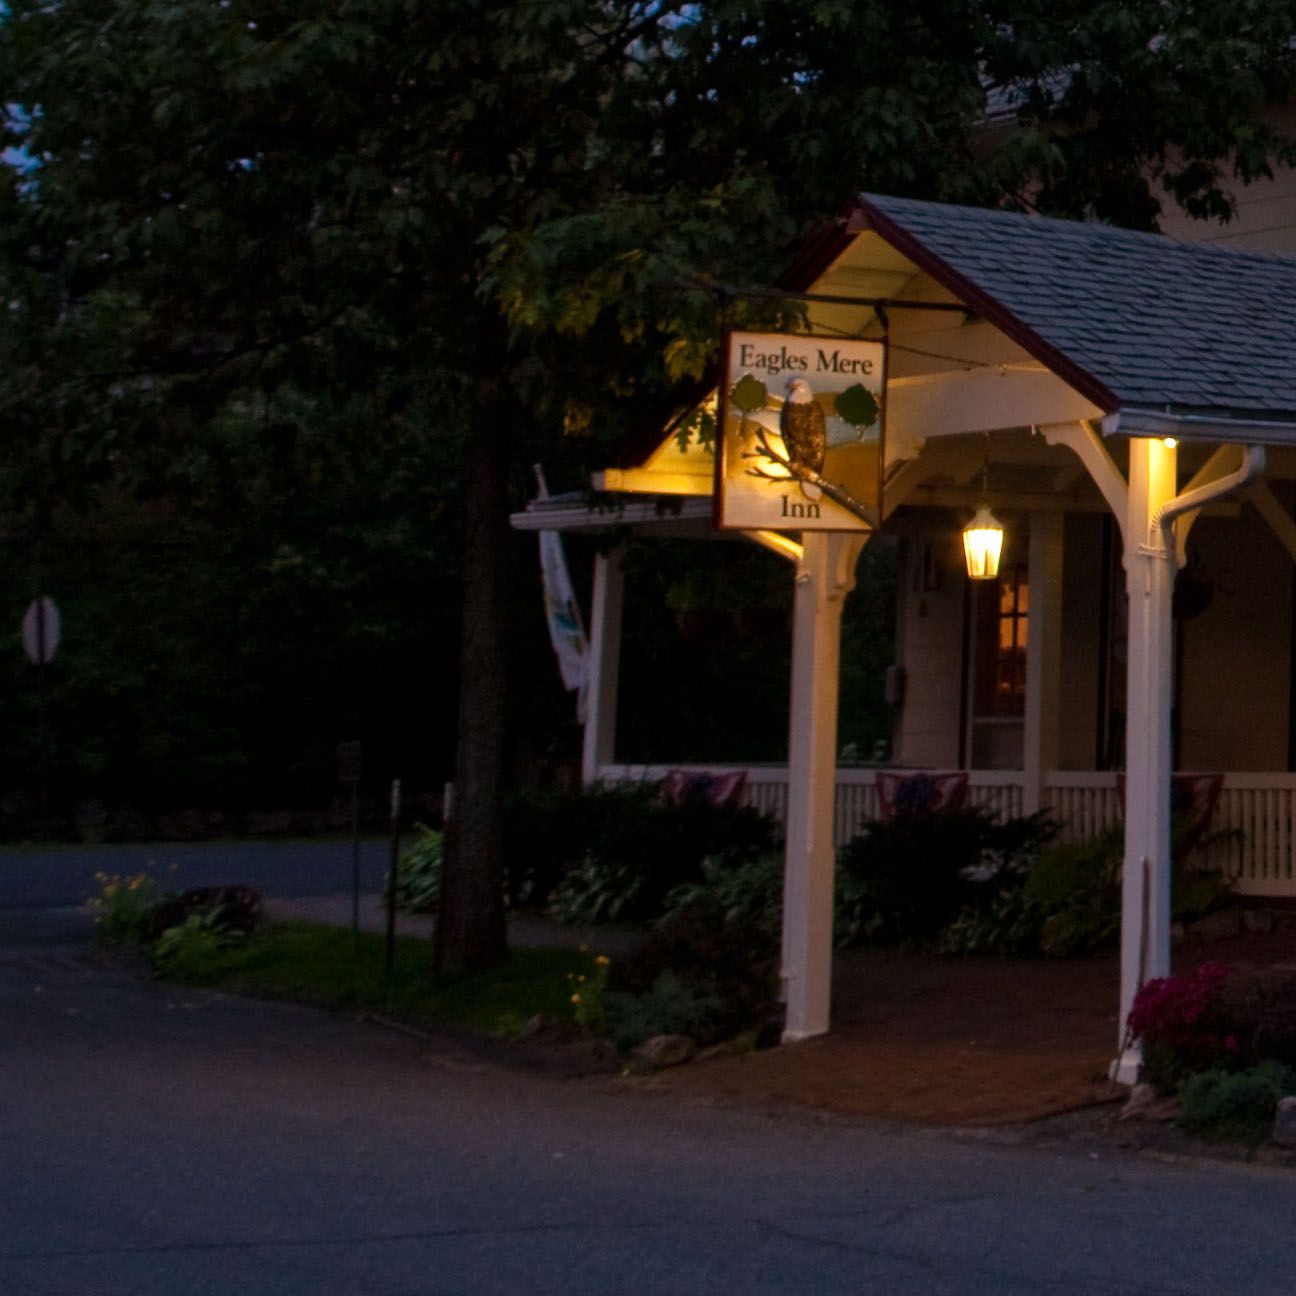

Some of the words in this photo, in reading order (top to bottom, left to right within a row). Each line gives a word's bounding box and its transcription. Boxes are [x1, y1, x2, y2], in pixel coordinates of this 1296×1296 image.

[740, 344, 808, 375] Eagles
[816, 350, 873, 375] Mere
[780, 495, 821, 519] Inn
